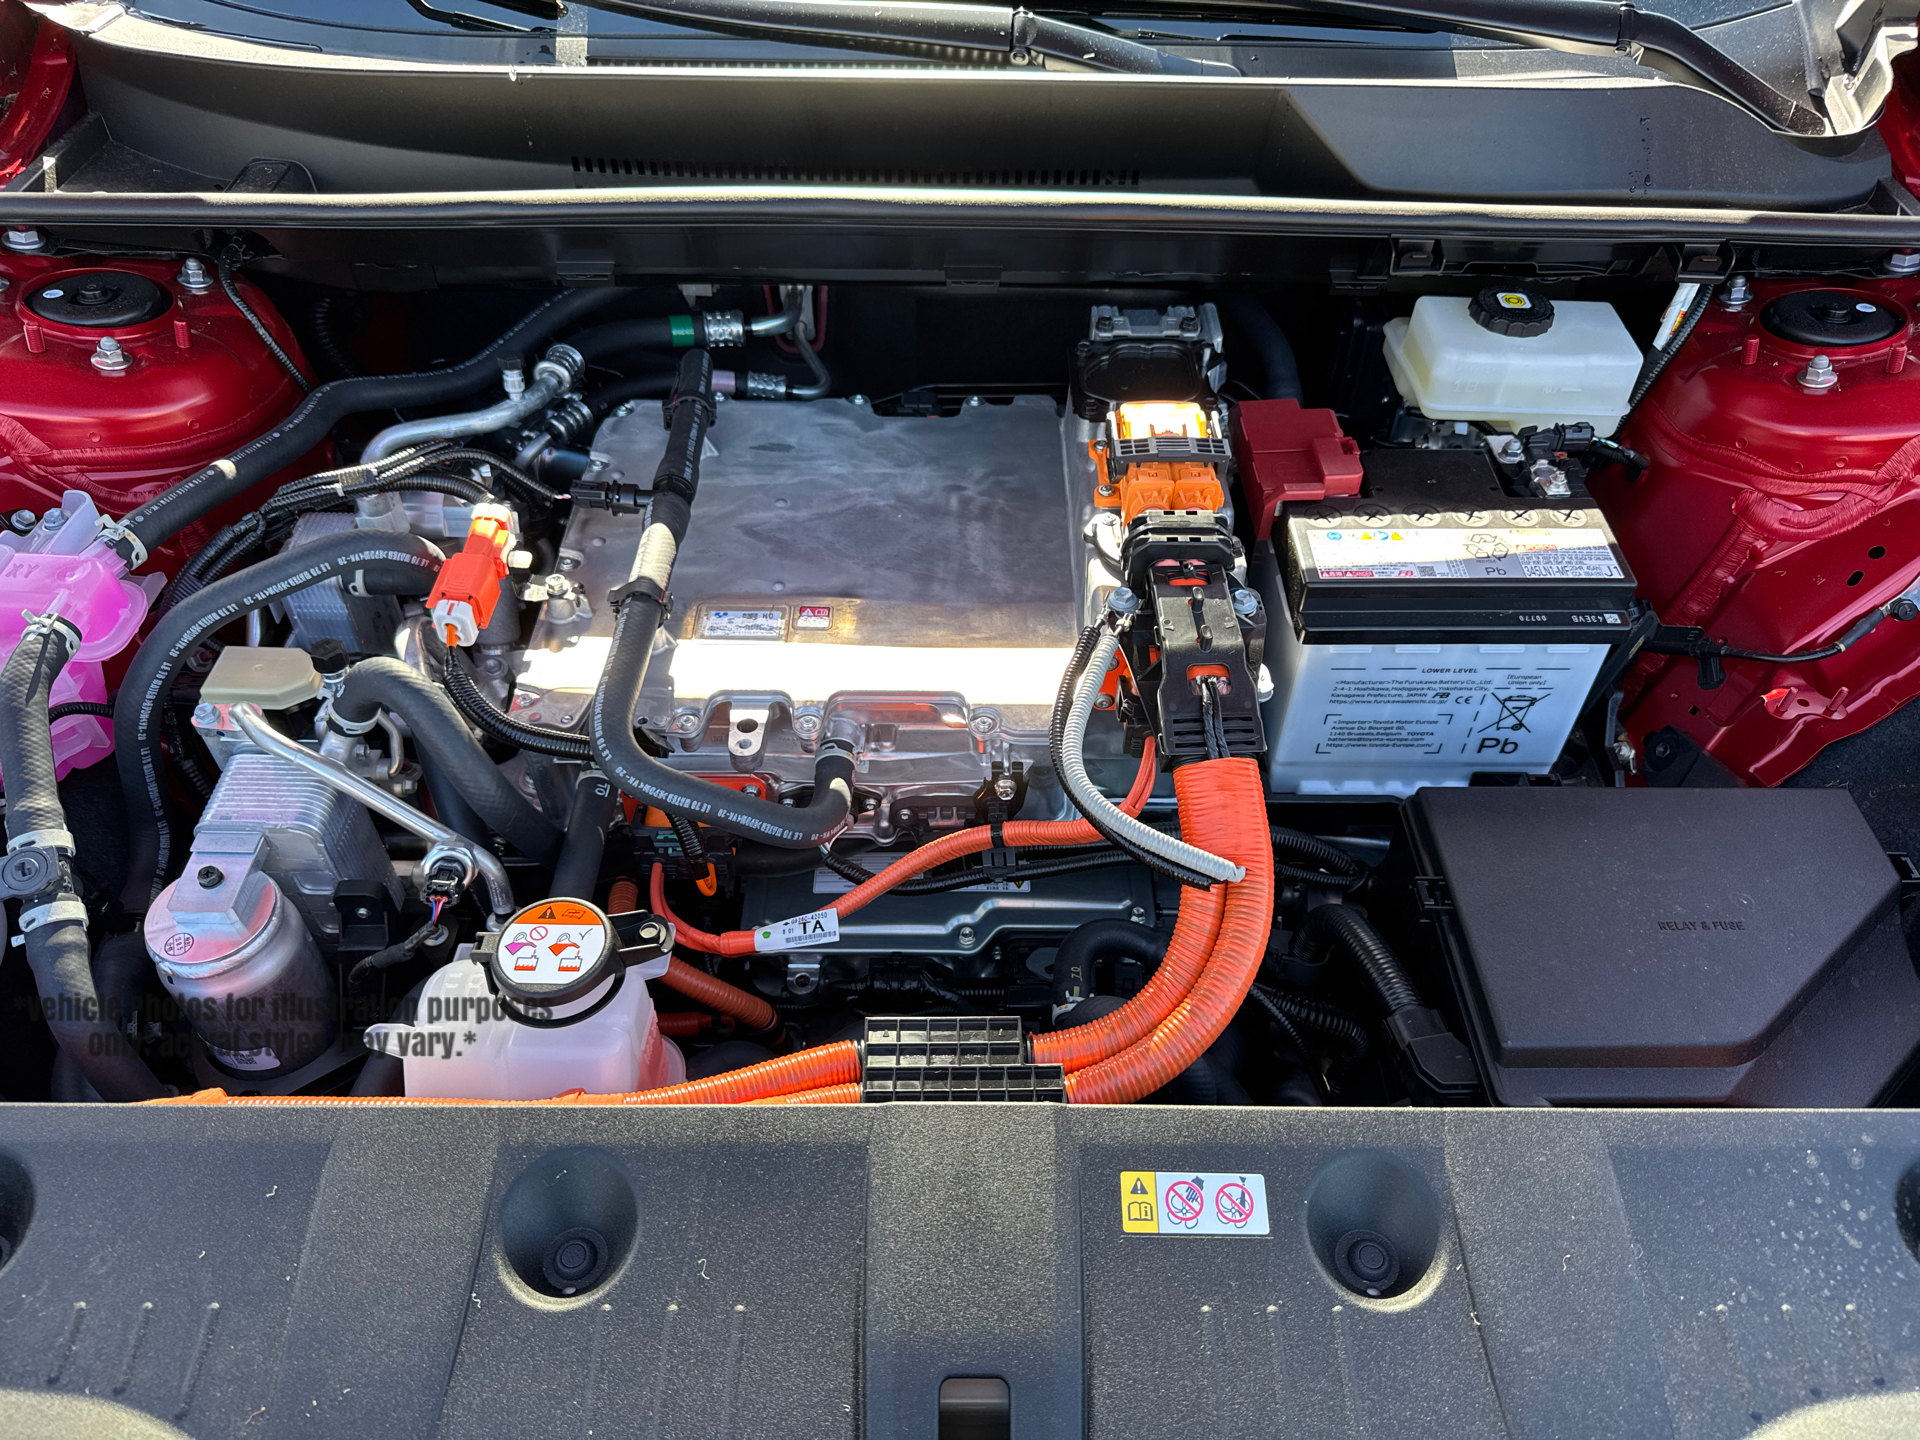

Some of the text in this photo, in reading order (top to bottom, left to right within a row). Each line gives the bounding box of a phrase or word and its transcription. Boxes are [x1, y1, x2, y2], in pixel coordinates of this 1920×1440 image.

[1485, 566, 1506, 576] Pb
[1476, 737, 1519, 754] Pb
[701, 803, 711, 813] LE
[793, 832, 803, 840] LE
[798, 920, 825, 934] TA
[1658, 921, 1745, 930] RELAY & FUSE
